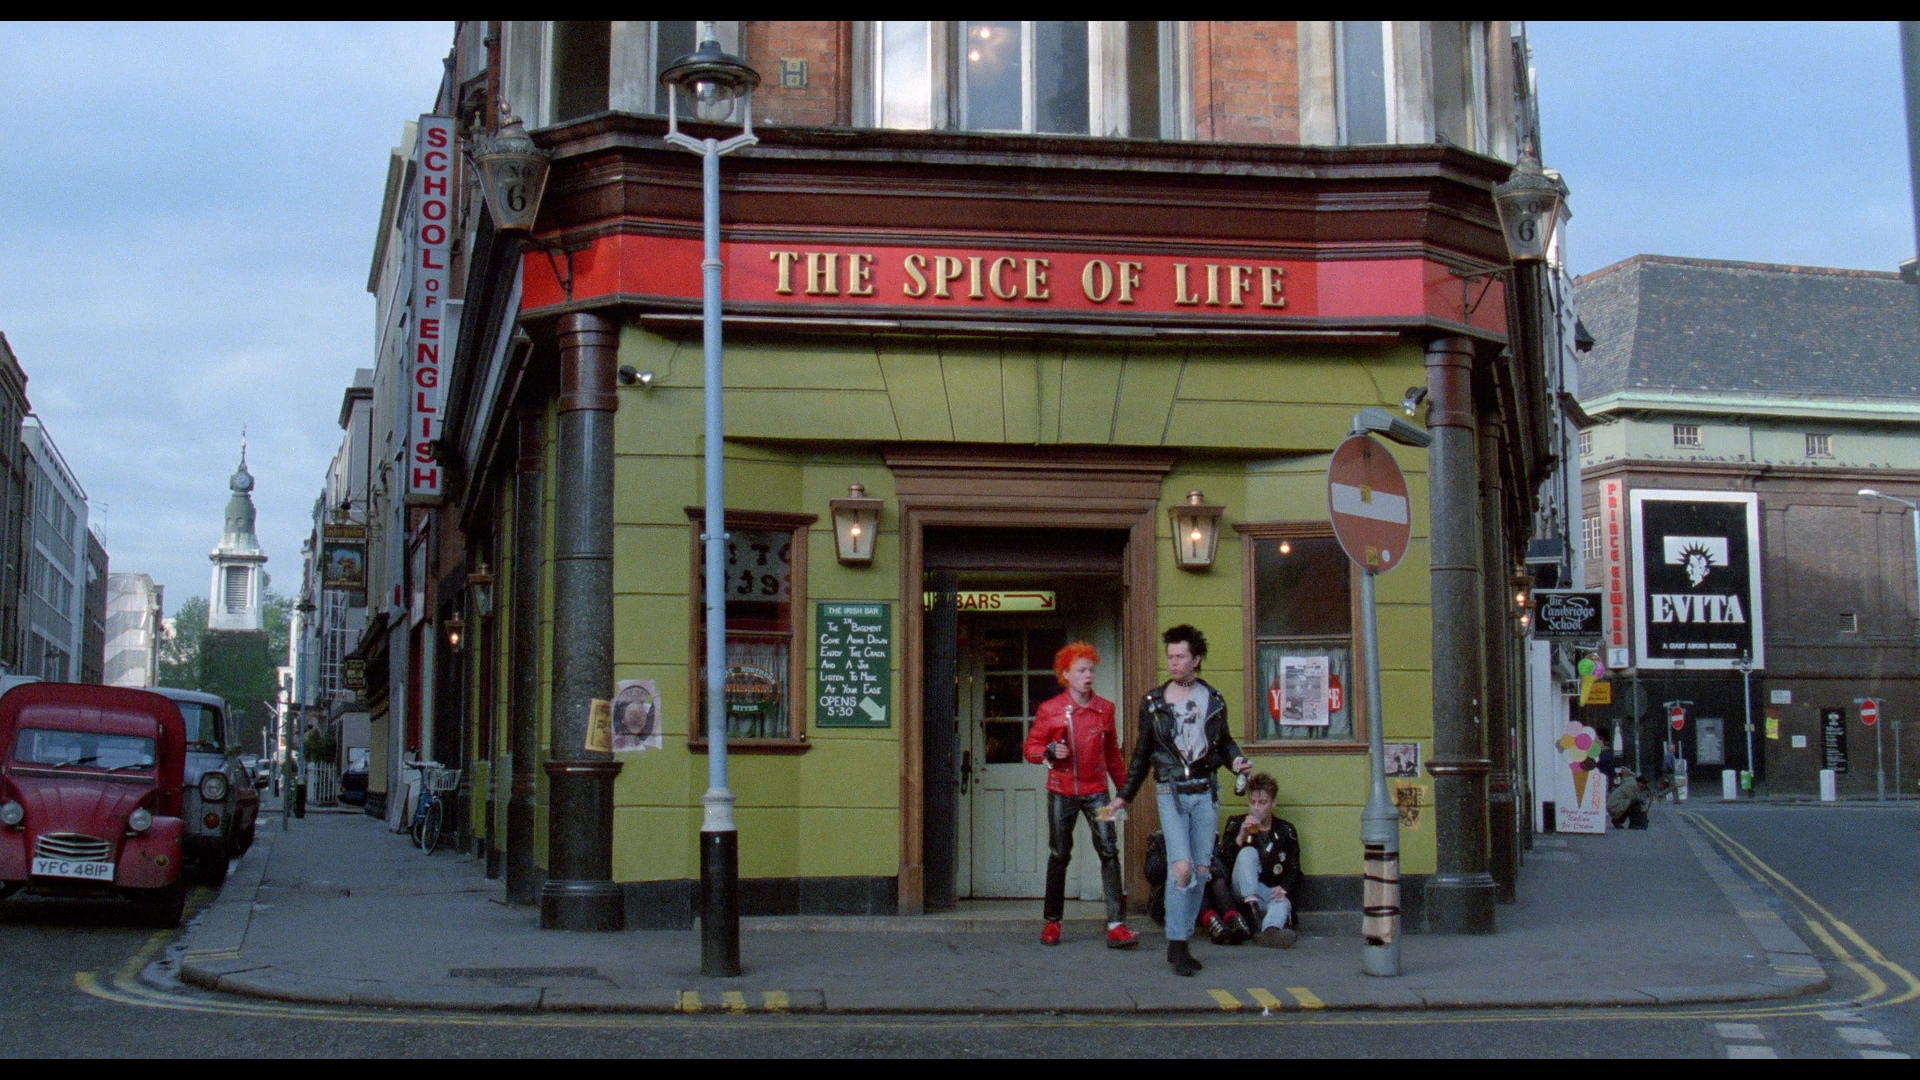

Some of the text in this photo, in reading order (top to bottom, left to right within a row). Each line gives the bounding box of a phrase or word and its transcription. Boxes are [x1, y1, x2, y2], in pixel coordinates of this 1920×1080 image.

[507, 183, 527, 212] 6
[1518, 219, 1535, 242] 6
[769, 250, 1286, 307] THE SPICE OF LIFE
[413, 127, 448, 489] SCHOOL OF ENGLISH
[1606, 483, 1619, 562] PRINCE
[828, 607, 879, 615] THE IRISH BAR
[1541, 600, 1596, 621] Cambridge
[1650, 594, 1746, 623] EVITA
[1548, 616, 1583, 630] School
[845, 659, 853, 669] A
[820, 696, 857, 707] OPENS
[38, 862, 109, 877] YFC 481P
